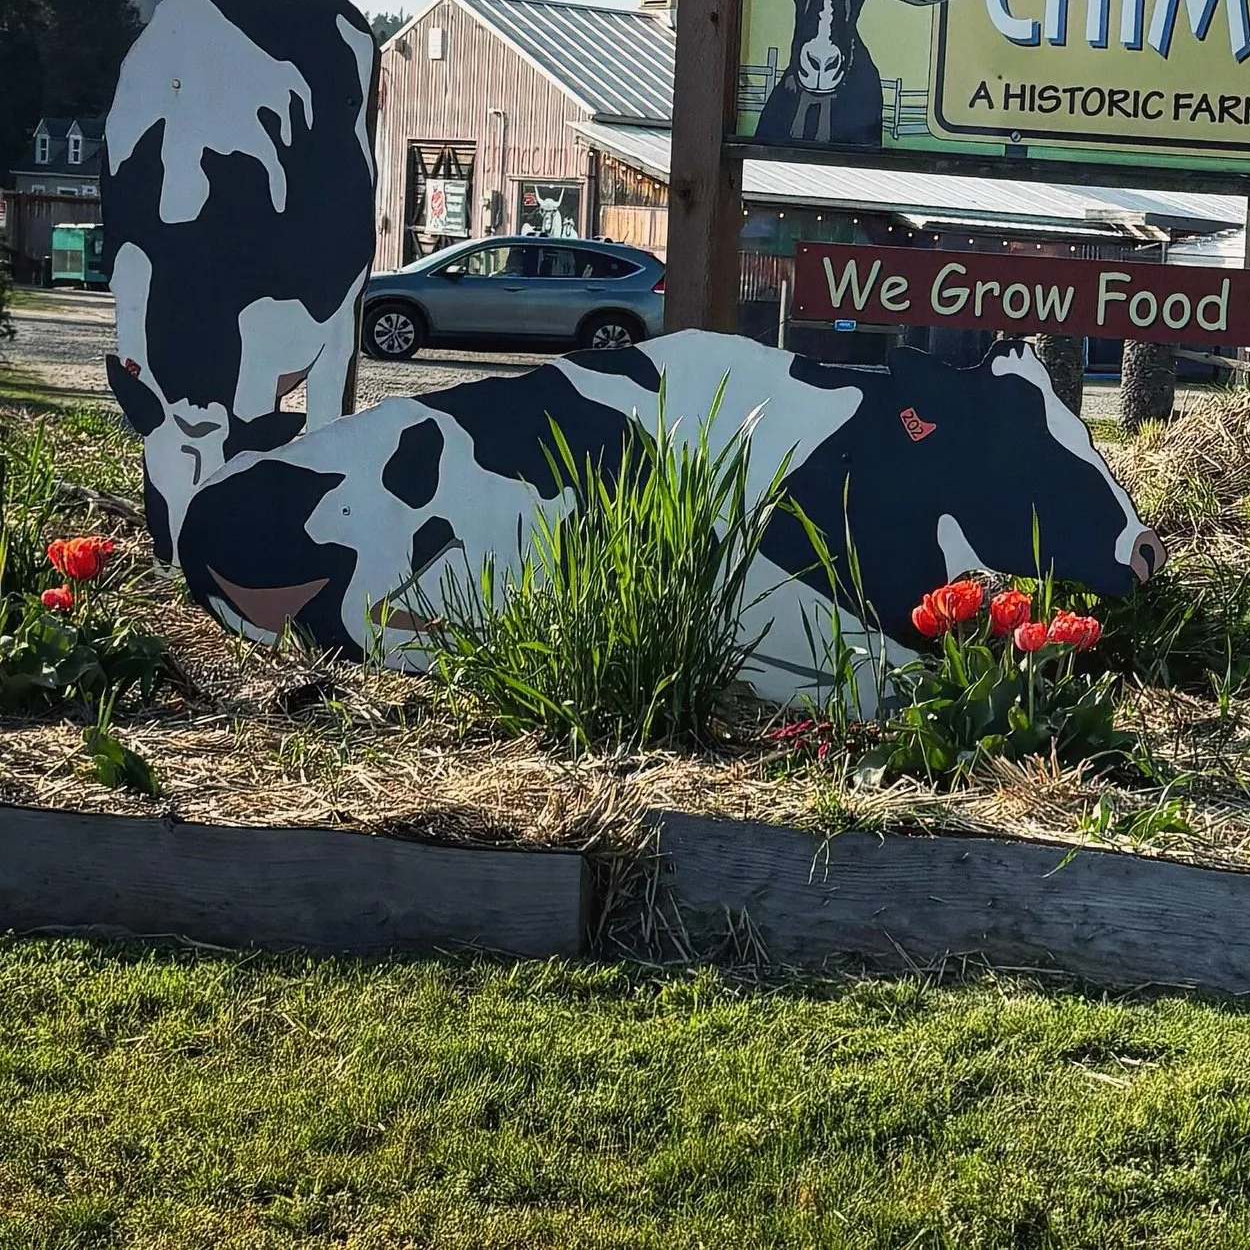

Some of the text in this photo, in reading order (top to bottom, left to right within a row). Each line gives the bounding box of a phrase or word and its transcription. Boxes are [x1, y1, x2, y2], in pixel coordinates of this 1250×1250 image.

[968, 80, 995, 110] A
[1002, 82, 1166, 121] HISTORIC
[822, 256, 911, 312] We
[930, 262, 1076, 323] Grow
[1096, 271, 1231, 332] Food
